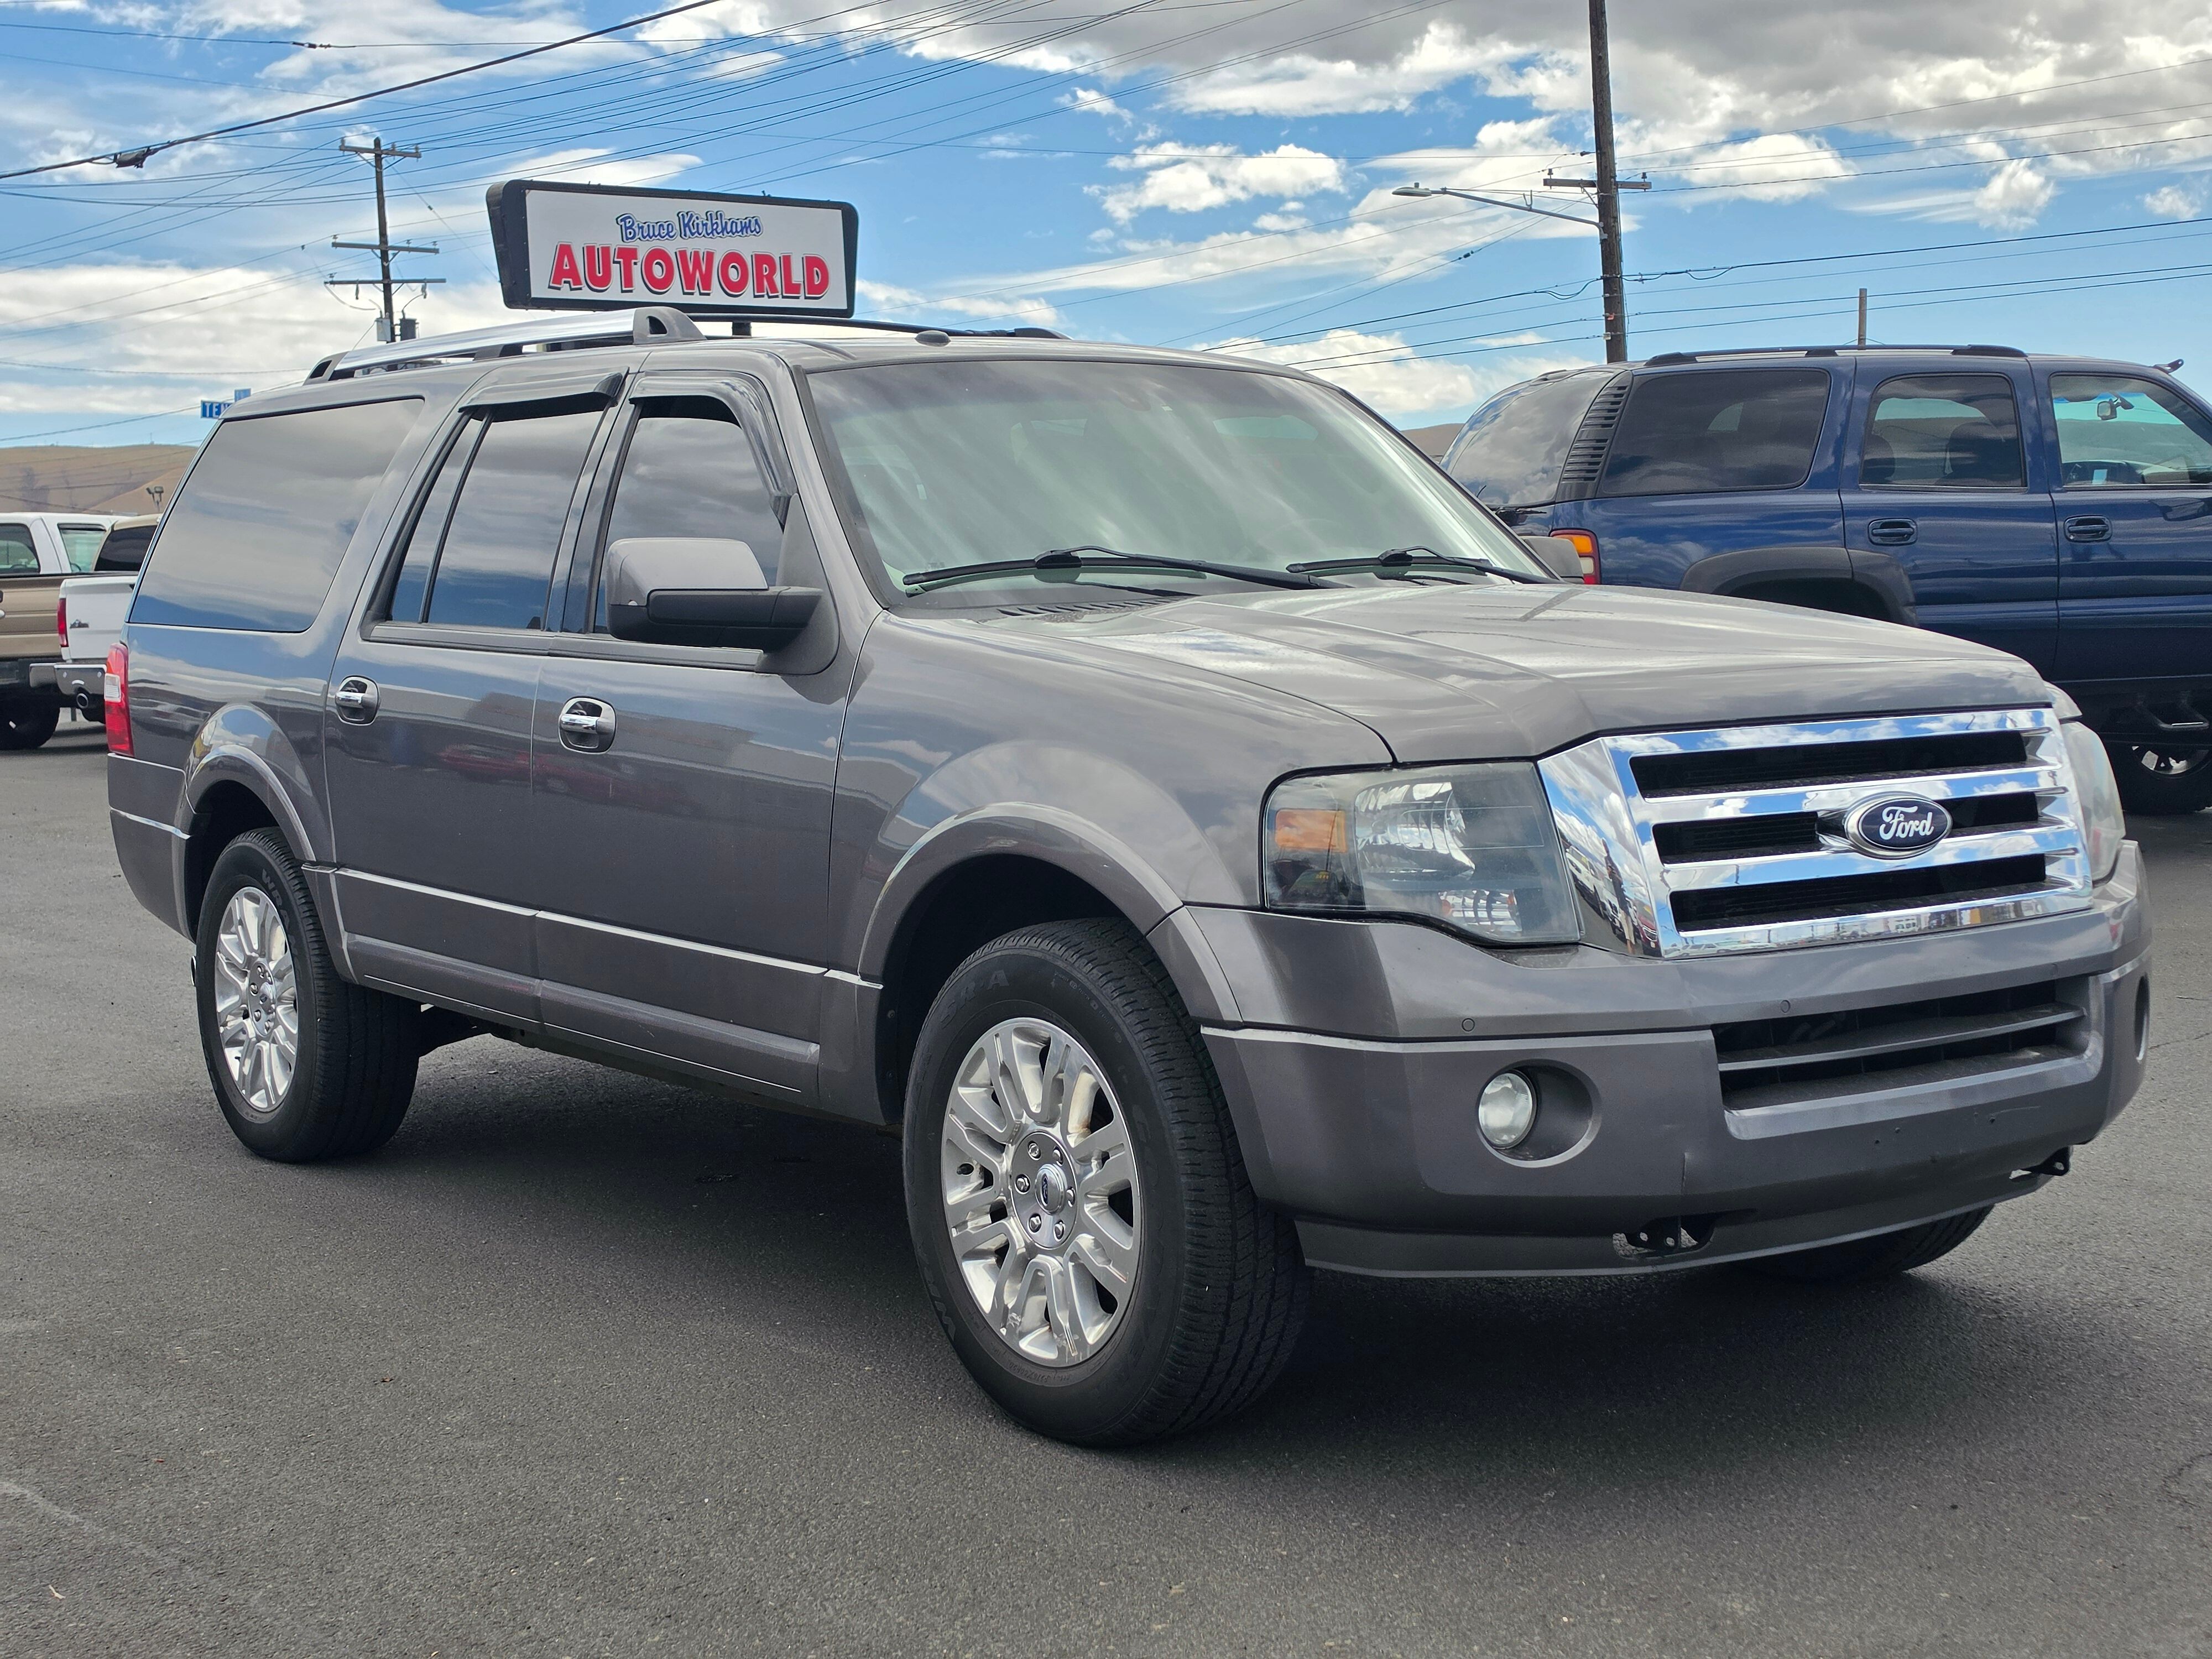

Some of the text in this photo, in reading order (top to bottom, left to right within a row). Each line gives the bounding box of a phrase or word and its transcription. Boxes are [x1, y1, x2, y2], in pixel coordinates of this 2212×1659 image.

[617, 211, 762, 241] Bruce Kirkhams
[550, 243, 830, 298] AUTOWORLD
[1879, 806, 1934, 840] Ford
